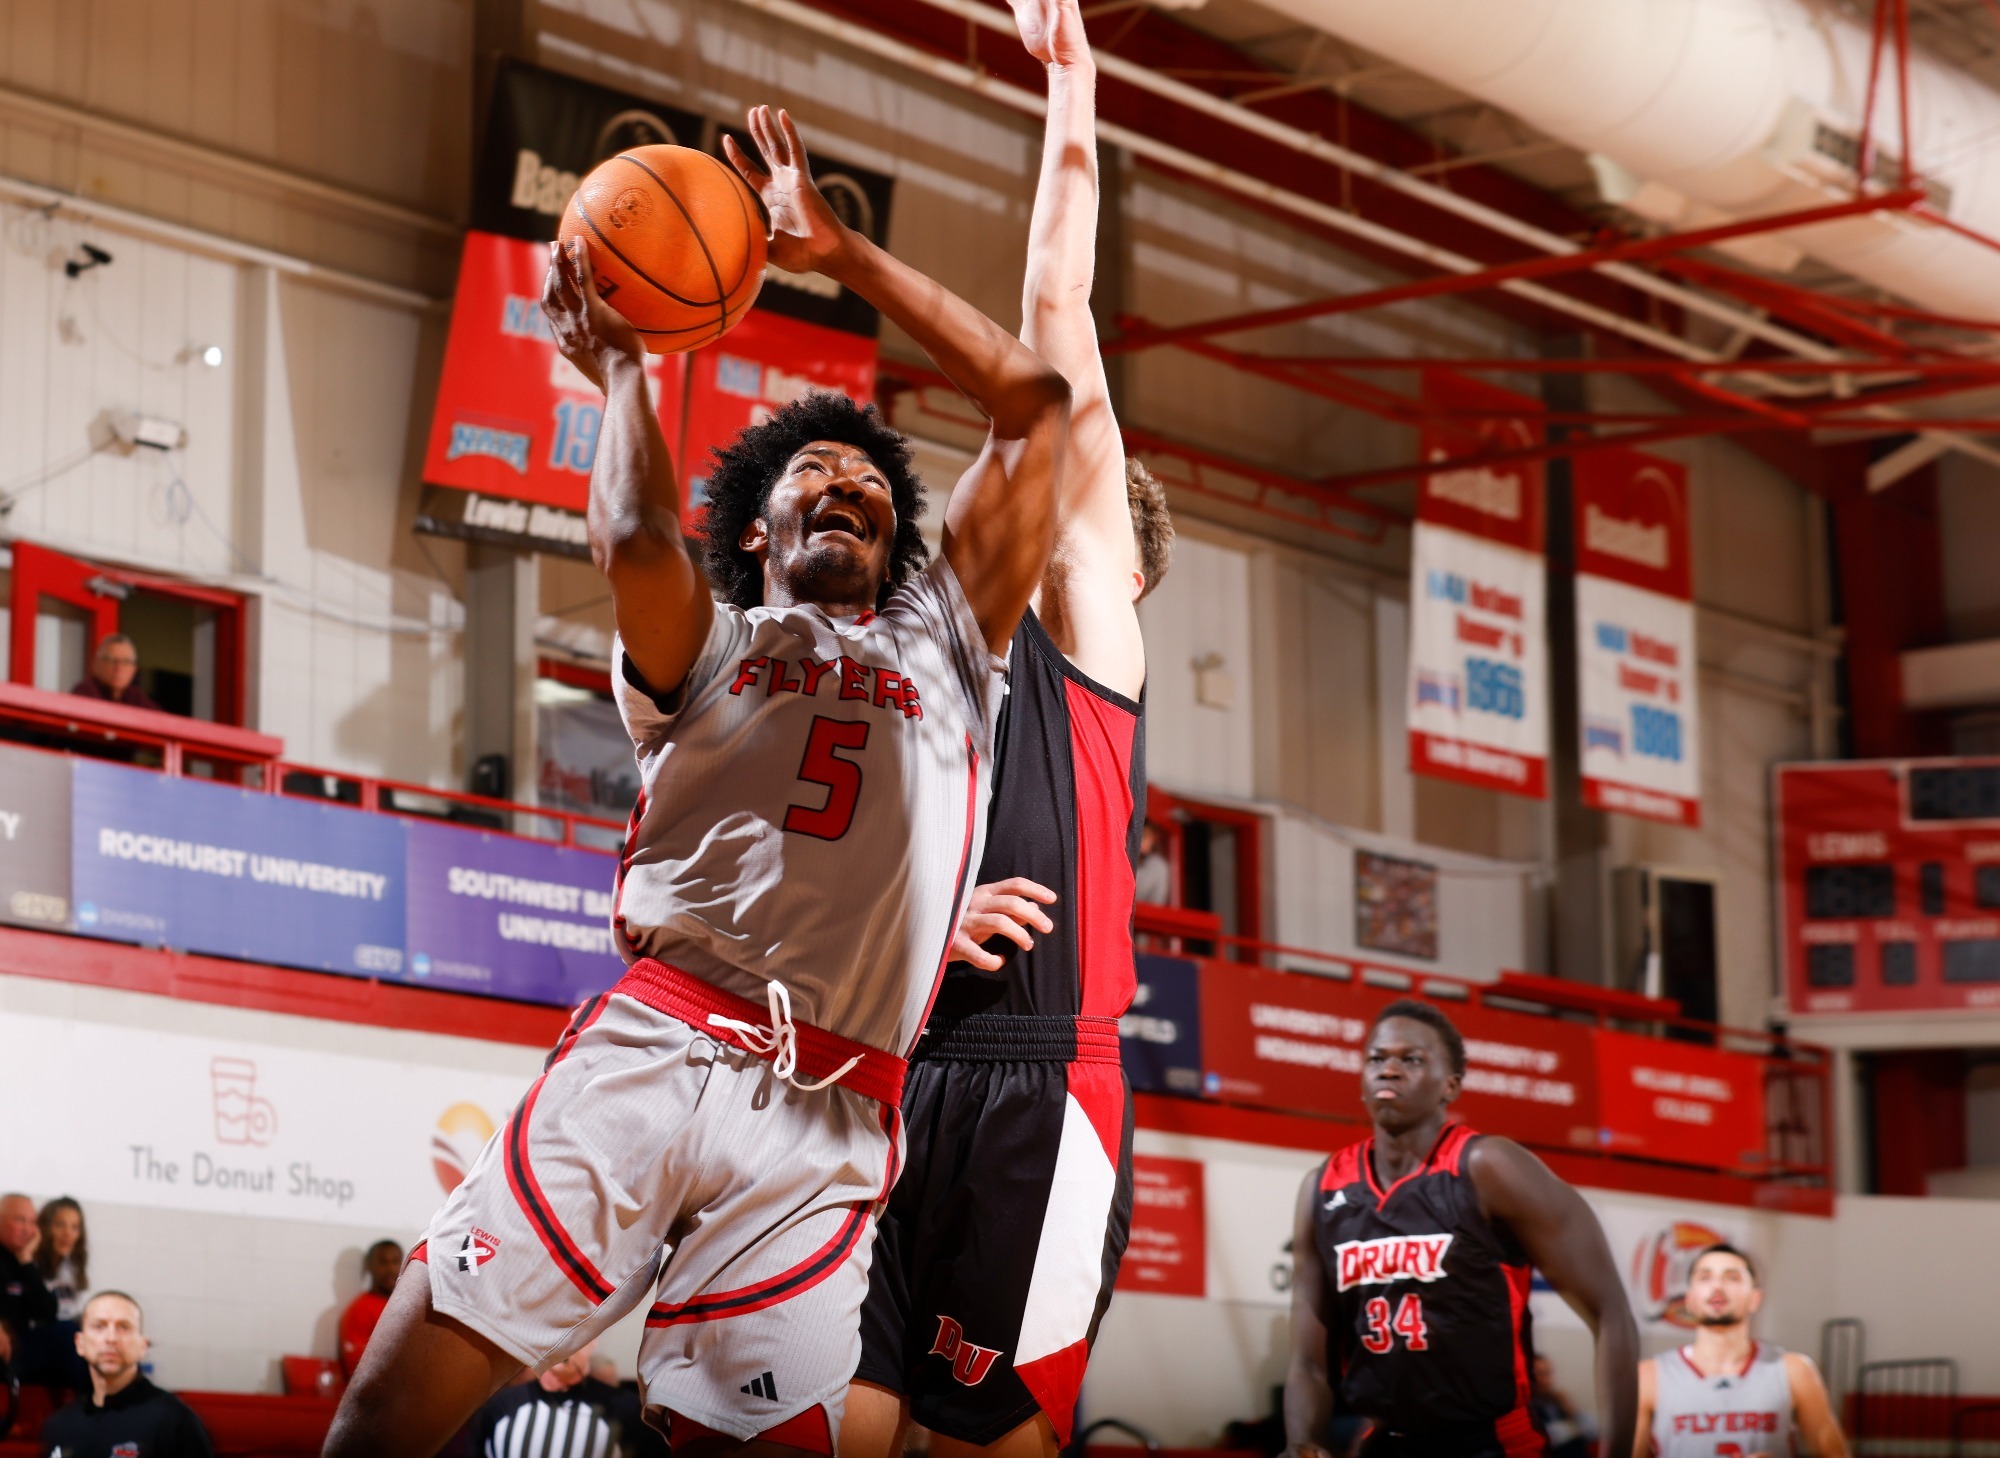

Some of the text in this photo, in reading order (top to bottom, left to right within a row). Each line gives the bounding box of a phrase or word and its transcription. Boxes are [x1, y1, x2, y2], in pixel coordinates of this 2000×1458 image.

[447, 421, 531, 477] NAIA
[551, 402, 602, 475] 19
[728, 655, 924, 722] FLYERS
[782, 714, 871, 842] 5
[98, 827, 386, 901] ROCKHURST UNIVERSITY
[447, 866, 581, 914] SOUTHWEST
[130, 1145, 356, 1208] The Donut Shop
[470, 1225, 502, 1247] LEWIS
[1334, 1233, 1454, 1292] DRURY
[1361, 1293, 1429, 1354] 34
[1673, 1411, 1779, 1434] FLYERS
